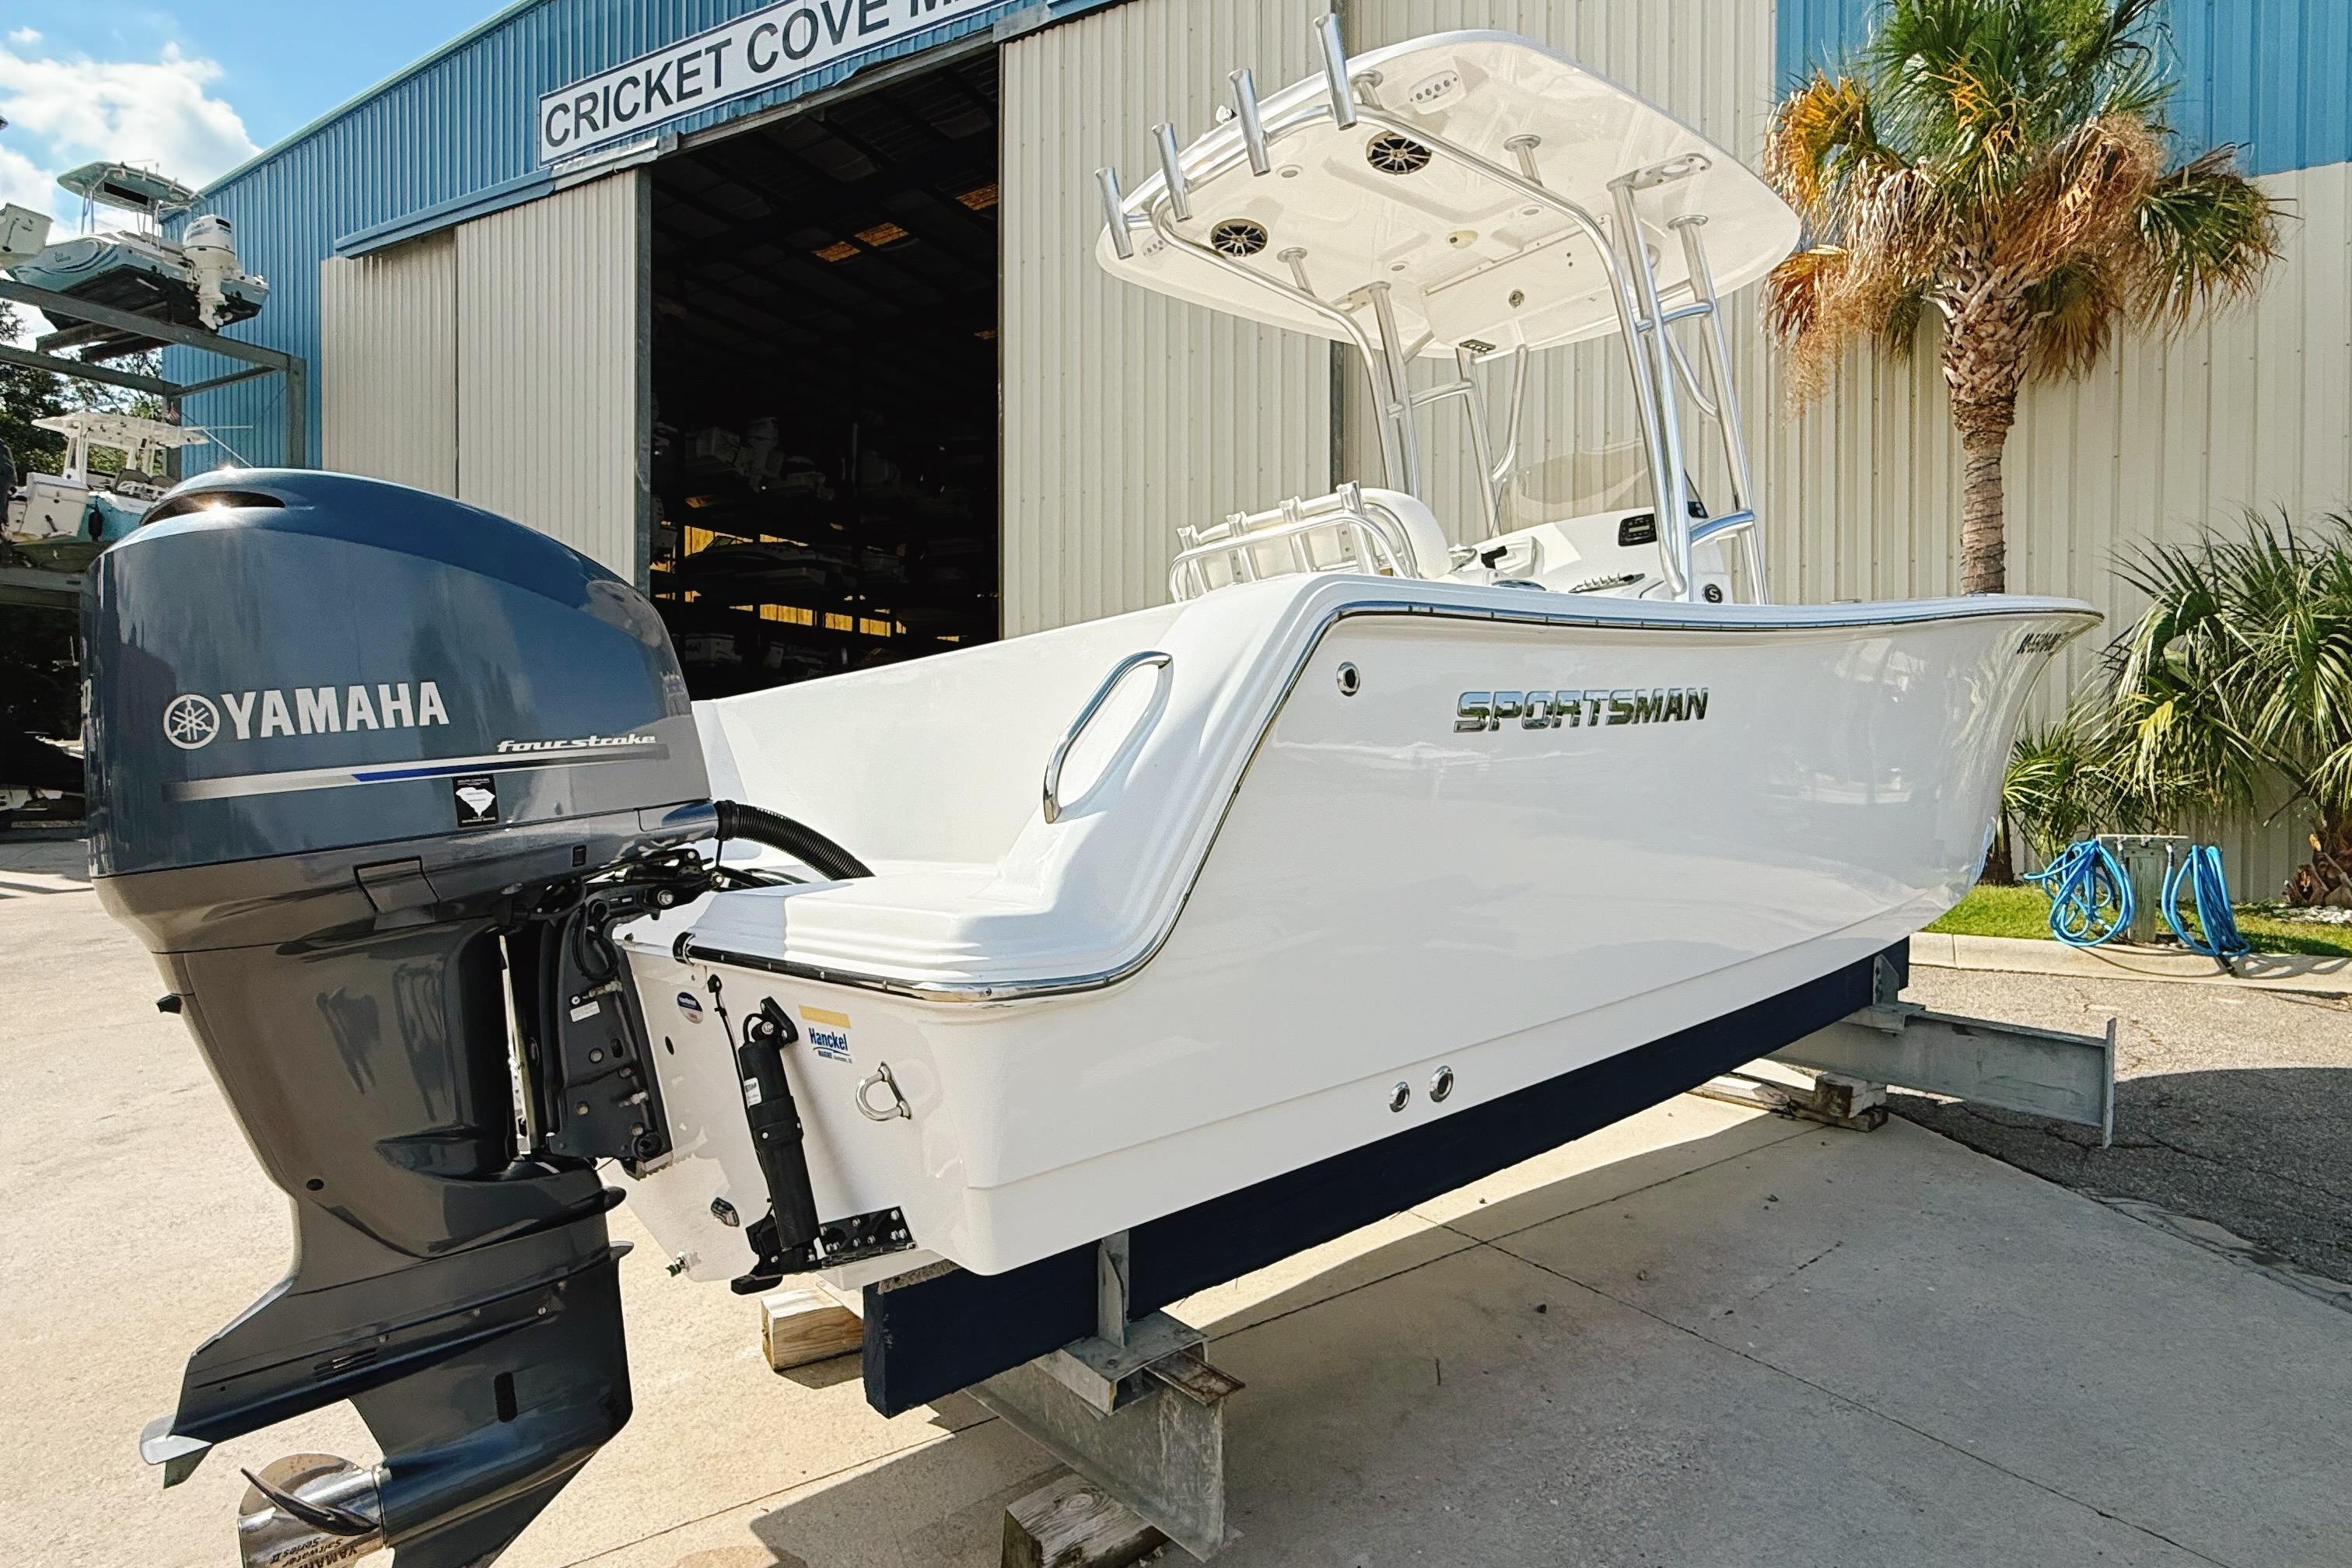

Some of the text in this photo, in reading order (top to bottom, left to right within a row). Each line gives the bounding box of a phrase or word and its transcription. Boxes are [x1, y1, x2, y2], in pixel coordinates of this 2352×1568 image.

[545, 0, 889, 148] CRICKET COVE
[221, 681, 450, 740] YAMAHA
[1453, 687, 1709, 733] SPORTSMAN
[808, 1027, 849, 1052] Hanckel
[282, 1538, 343, 1567] Saltwater
[298, 1545, 358, 1568] YAMA
